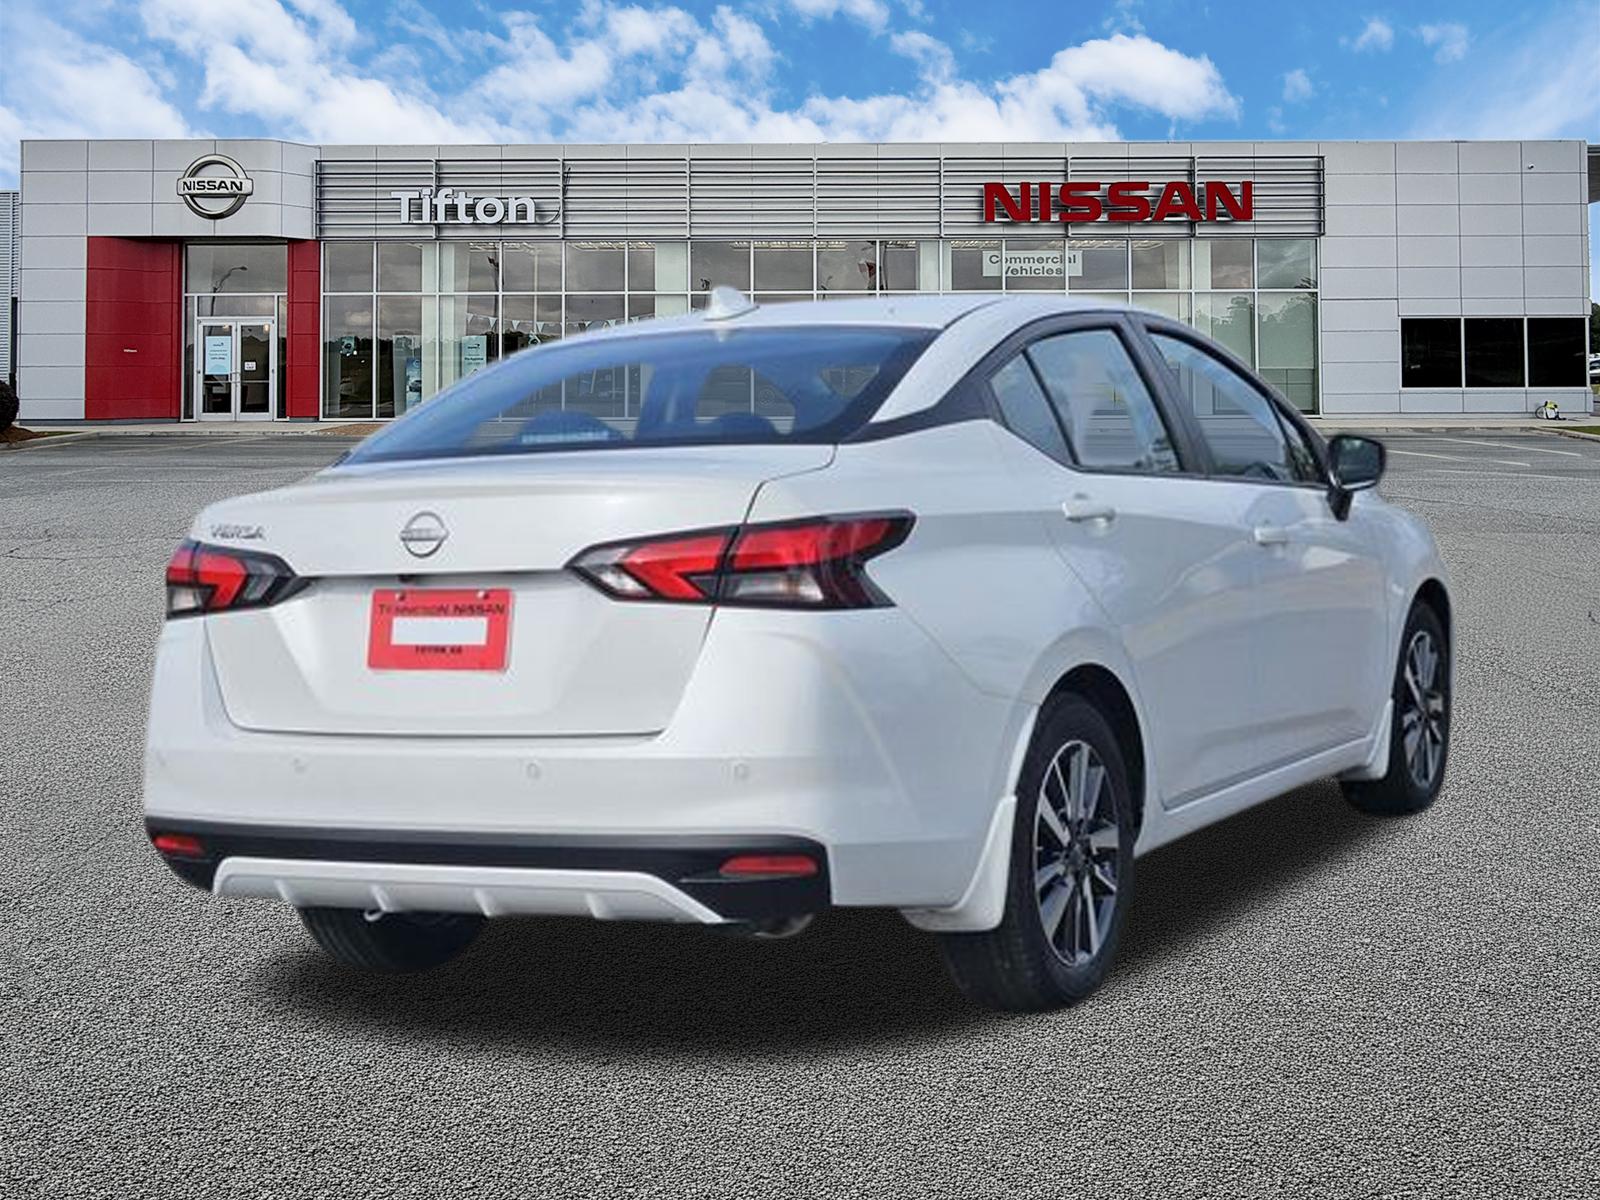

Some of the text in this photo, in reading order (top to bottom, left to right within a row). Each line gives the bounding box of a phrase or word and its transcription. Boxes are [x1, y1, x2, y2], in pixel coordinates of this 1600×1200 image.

[182, 180, 243, 191] NISSAN
[391, 188, 536, 224] Tifton
[983, 181, 1254, 222] NISSAN
[988, 254, 1077, 265] Cmmercil
